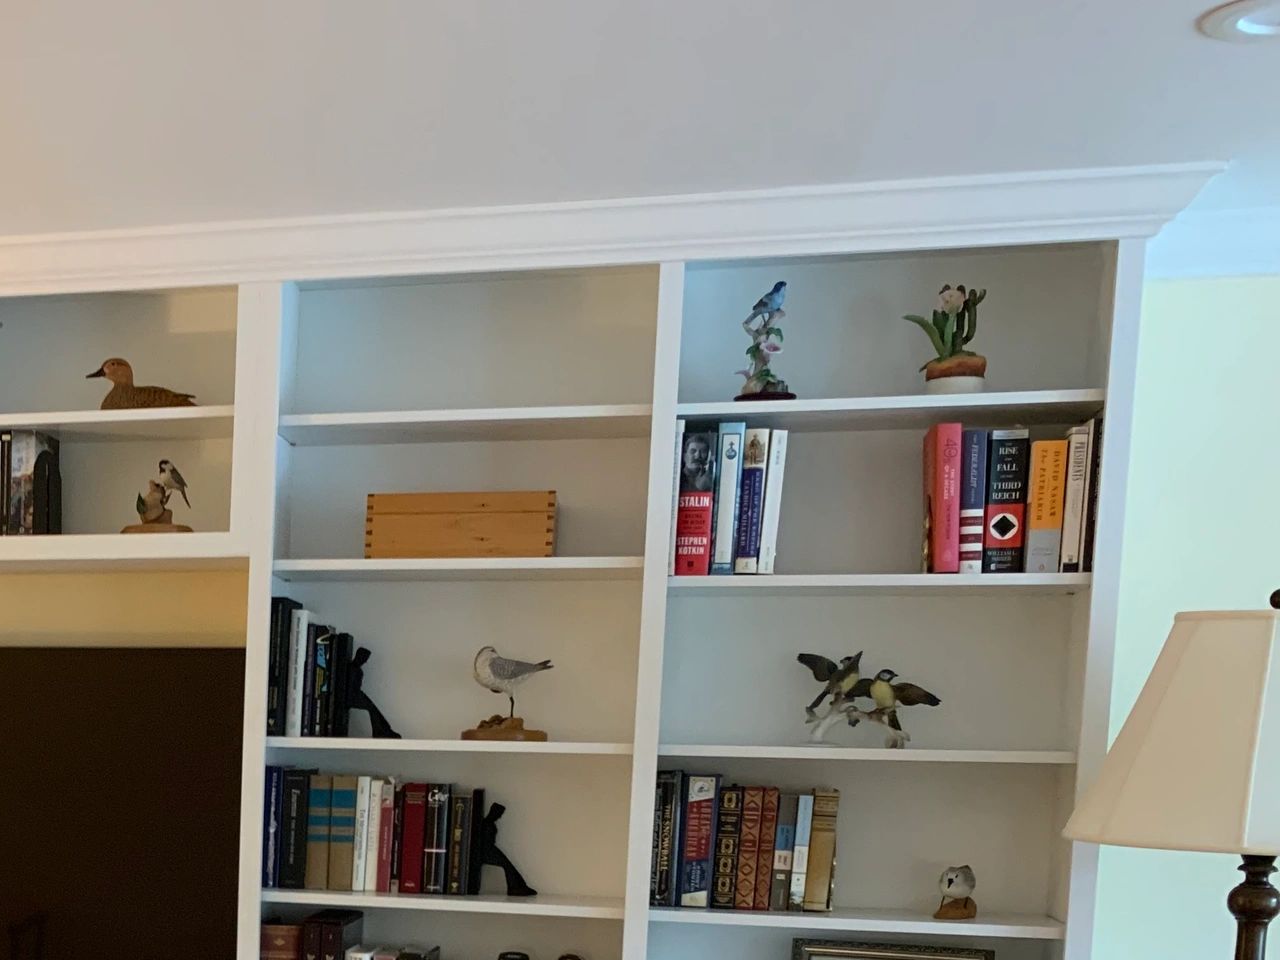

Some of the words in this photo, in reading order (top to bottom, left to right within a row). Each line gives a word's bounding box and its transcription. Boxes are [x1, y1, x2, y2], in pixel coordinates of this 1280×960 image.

[999, 447, 1018, 455] RISE
[1053, 450, 1061, 481] DAVID
[1071, 441, 1085, 481] PRESIDENTS
[992, 481, 1021, 489] THIRD
[992, 491, 1020, 500] REICH
[1036, 467, 1046, 521] PATRIARCH
[680, 496, 710, 508] STALIN
[677, 536, 707, 545] STEPHEN
[678, 546, 704, 555] KOTKIN
[660, 820, 670, 872] SNOWBALL
